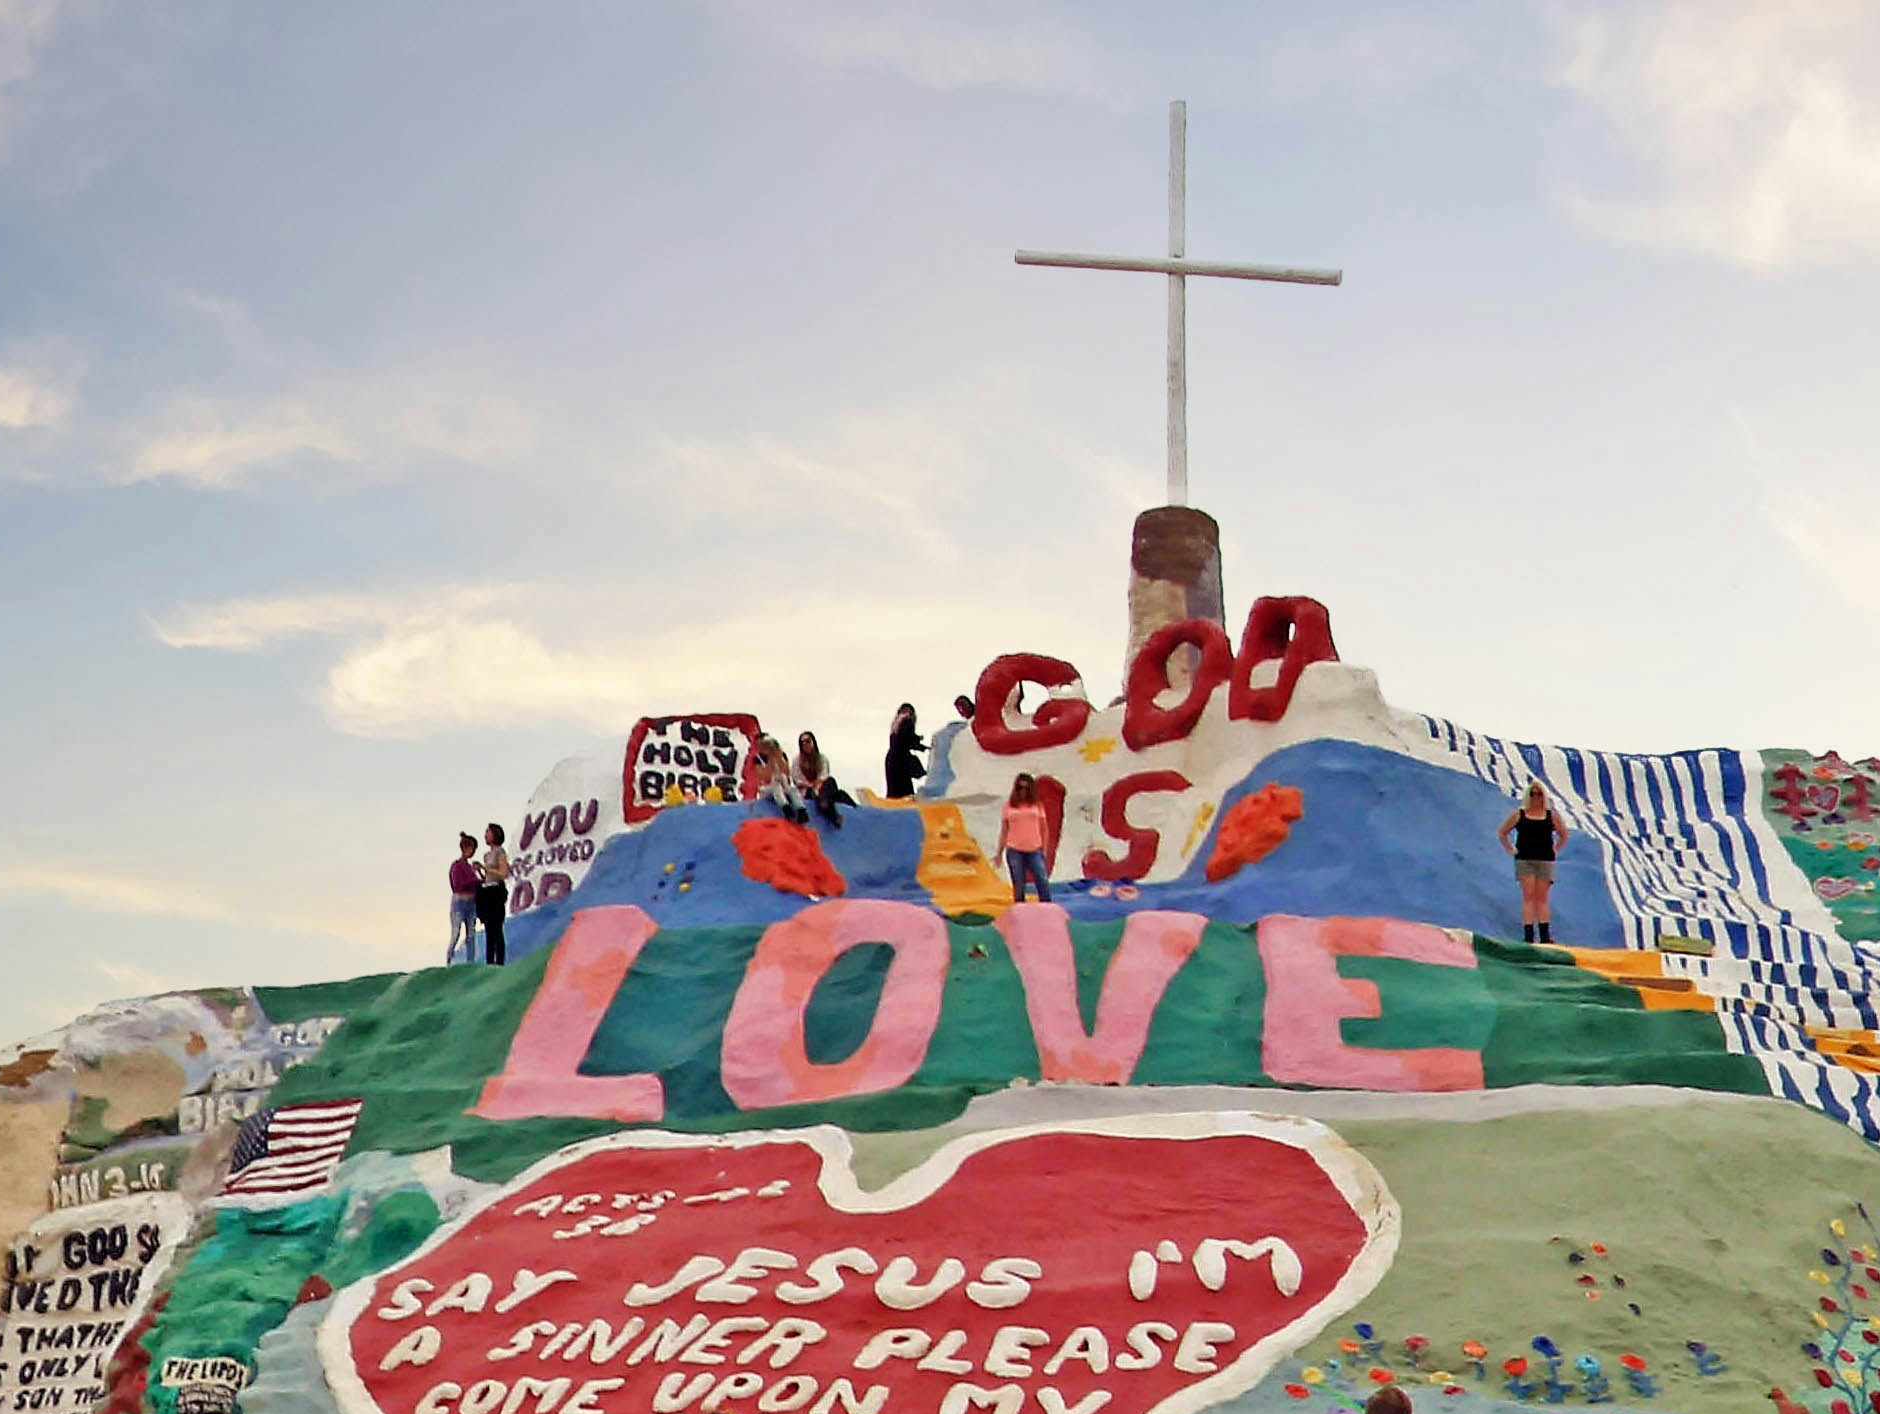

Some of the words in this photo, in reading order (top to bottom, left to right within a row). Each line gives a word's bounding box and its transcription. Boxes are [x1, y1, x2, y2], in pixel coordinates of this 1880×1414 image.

[971, 596, 1341, 756] GOD
[650, 719, 735, 747] THE
[642, 742, 738, 774] HOLY
[519, 798, 599, 851] YOU
[470, 899, 1485, 1121] LOVE
[63, 1223, 129, 1271] GOD
[377, 1265, 578, 1320] SAY
[623, 1247, 1042, 1312] JESUS
[1127, 1237, 1304, 1302] I'M
[19, 1351, 92, 1386] ONLY
[166, 1360, 200, 1380] THE
[378, 1325, 443, 1371] A
[487, 1314, 826, 1369] SINNER
[853, 1321, 1236, 1378] PLEASE
[14, 1387, 64, 1411] SON
